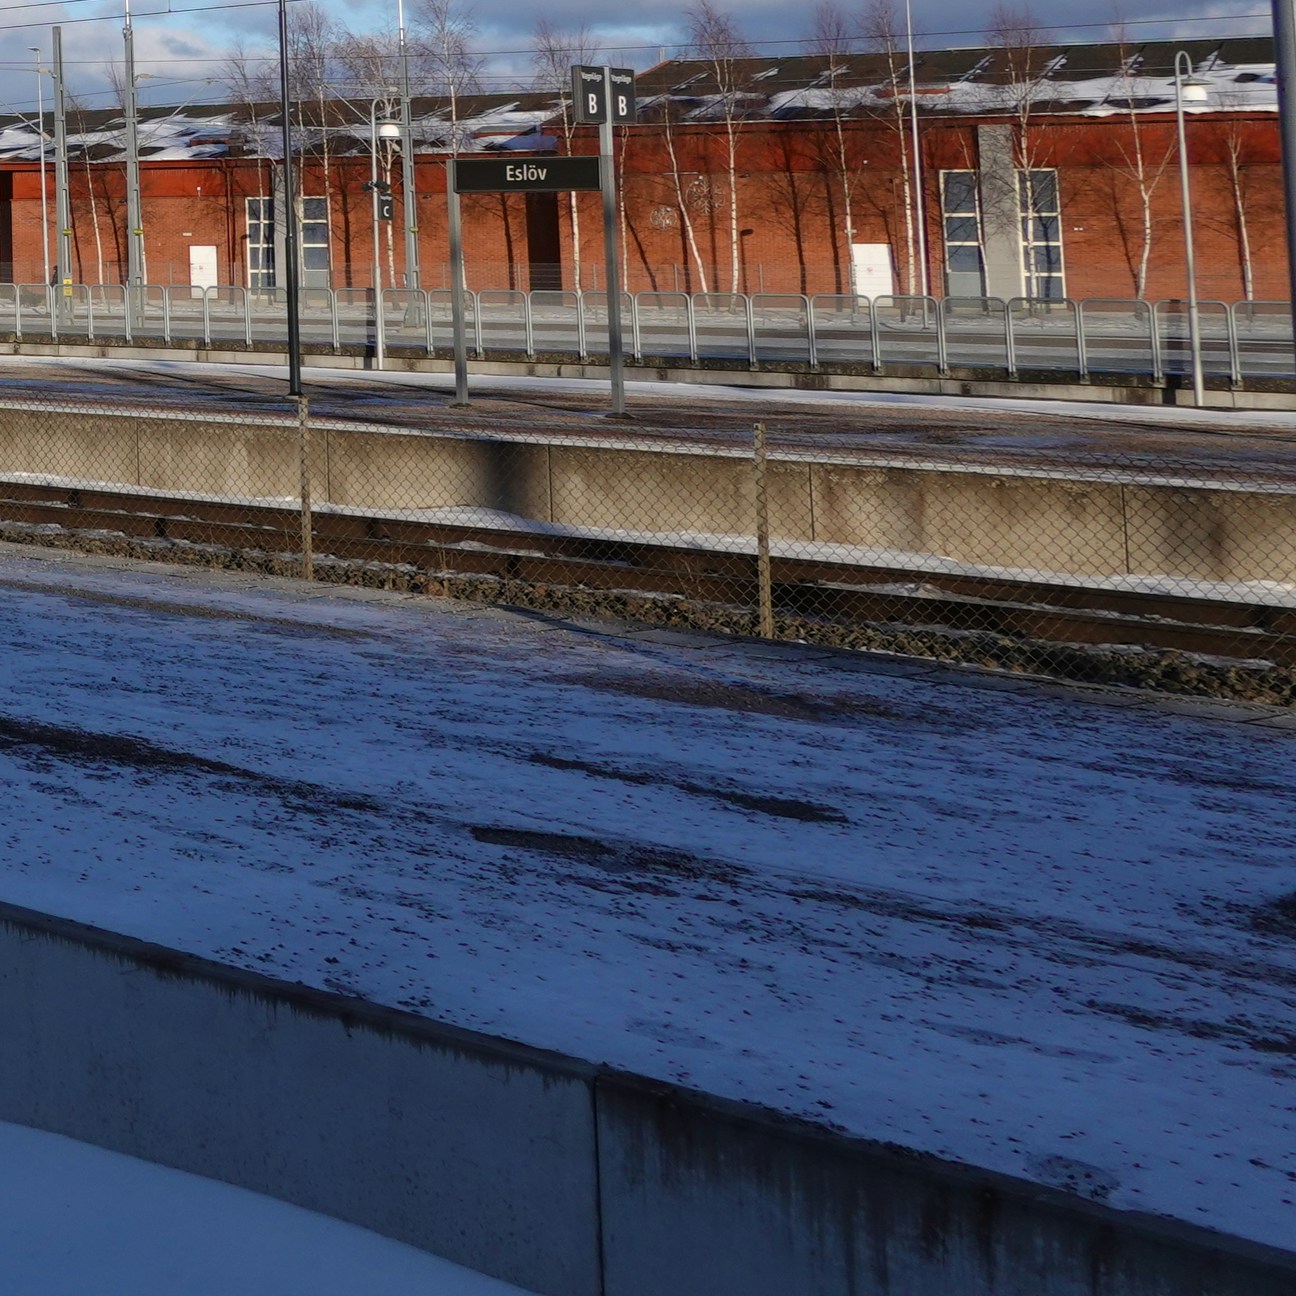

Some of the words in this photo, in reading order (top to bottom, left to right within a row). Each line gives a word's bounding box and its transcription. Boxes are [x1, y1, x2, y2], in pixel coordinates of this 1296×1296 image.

[588, 93, 598, 114] B
[618, 95, 628, 116] B
[506, 164, 547, 181] Eslöv
[383, 205, 390, 217] C
